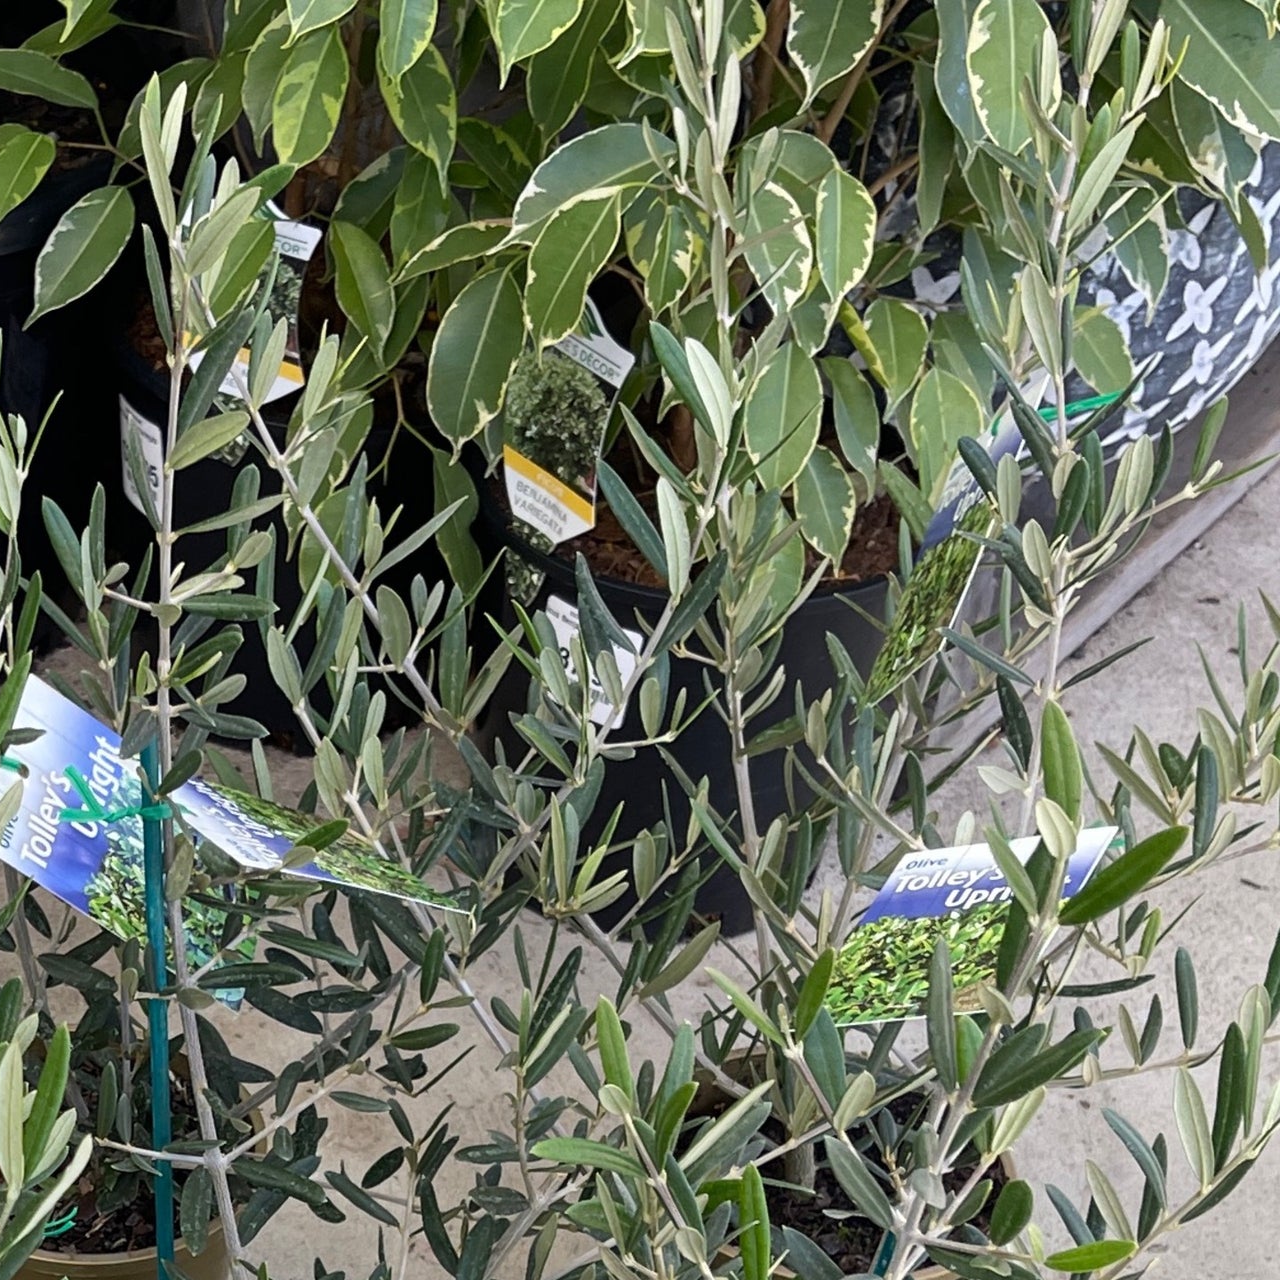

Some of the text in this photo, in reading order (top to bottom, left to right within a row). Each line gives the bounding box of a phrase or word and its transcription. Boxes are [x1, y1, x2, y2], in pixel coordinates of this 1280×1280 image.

[905, 857, 949, 870] Olive
[894, 865, 1005, 893] Tolley's
[944, 886, 1013, 910] Upri
